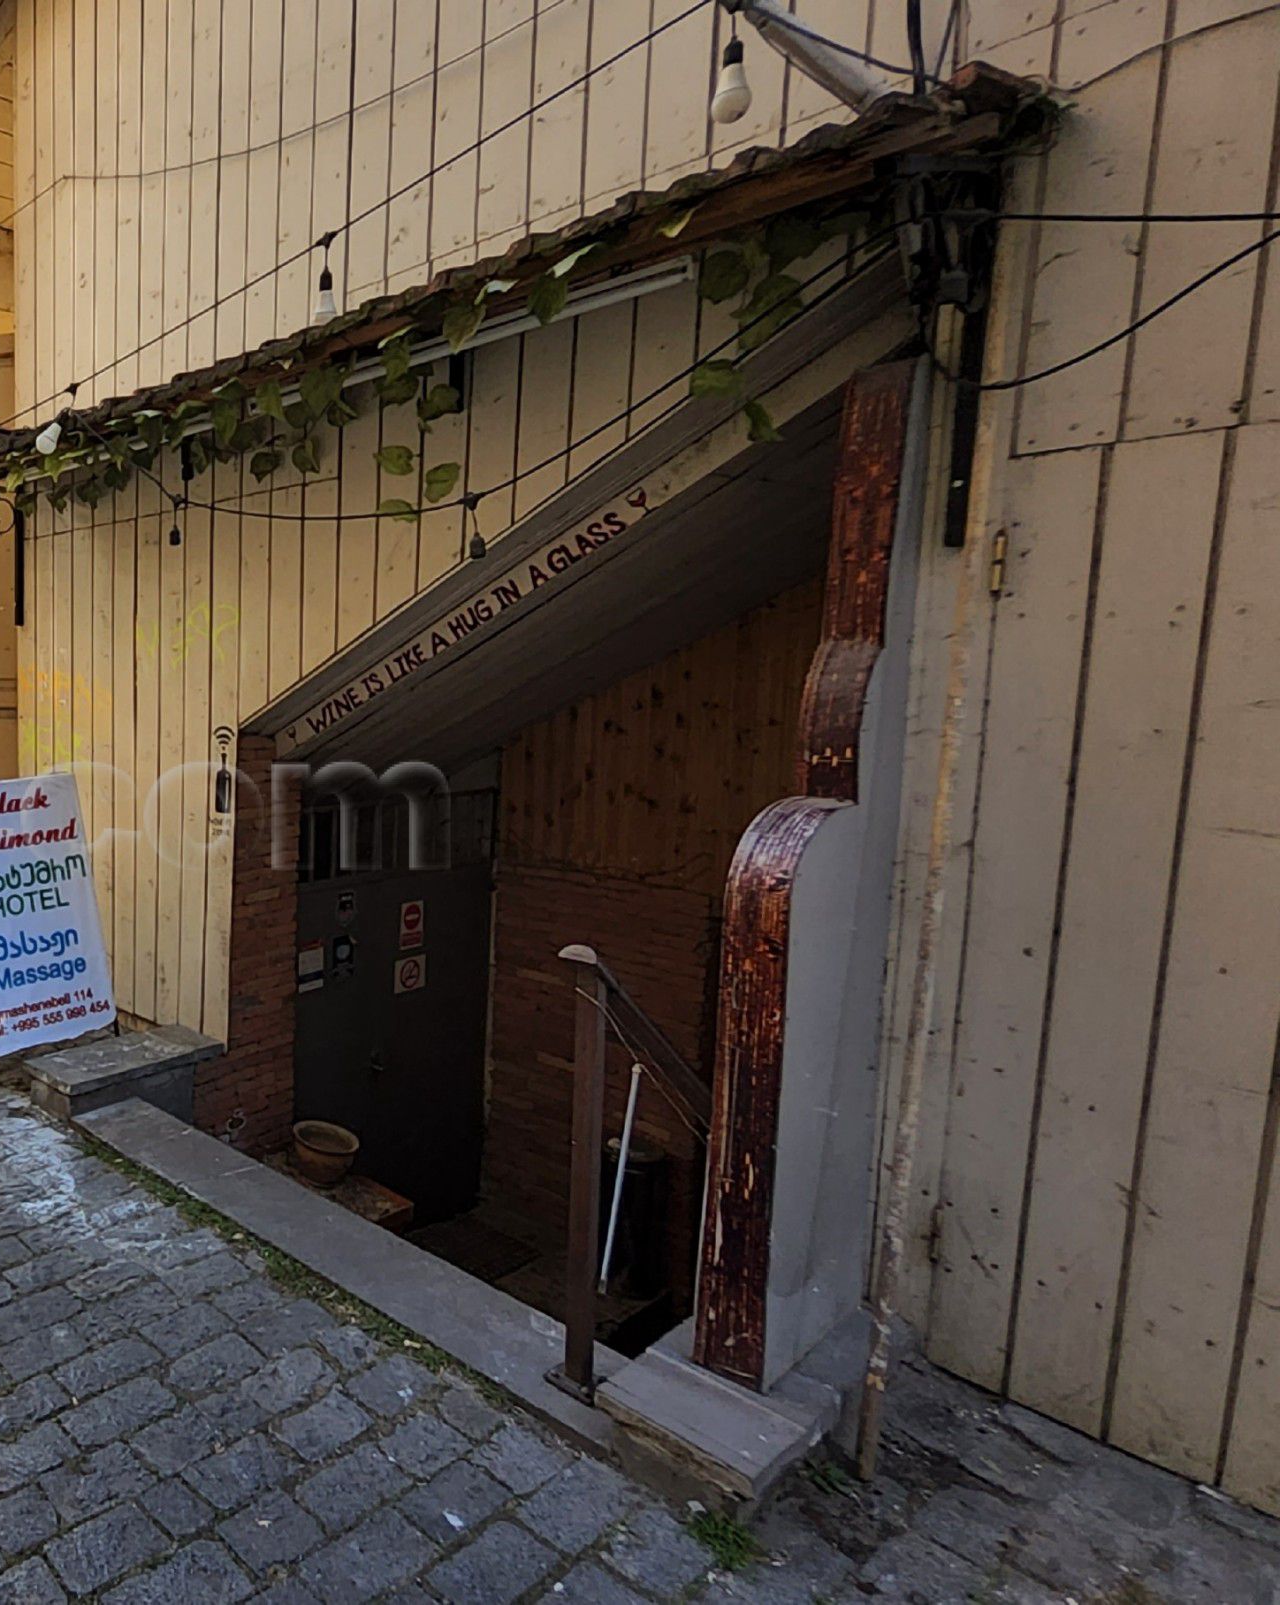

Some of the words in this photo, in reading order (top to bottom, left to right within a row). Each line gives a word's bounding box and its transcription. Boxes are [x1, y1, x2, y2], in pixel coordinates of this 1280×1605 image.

[306, 687, 363, 735] WINE
[362, 673, 385, 700] IS
[385, 643, 427, 683] LIKE
[429, 631, 451, 660] A
[447, 598, 494, 642] HUG
[490, 578, 522, 613] IN
[528, 563, 550, 591] A
[546, 511, 628, 575] GLASS
[74, 987, 94, 1001] 114
[11, 1015, 40, 1032] +995
[42, 1010, 64, 1026] 555
[89, 998, 111, 1014] 454
